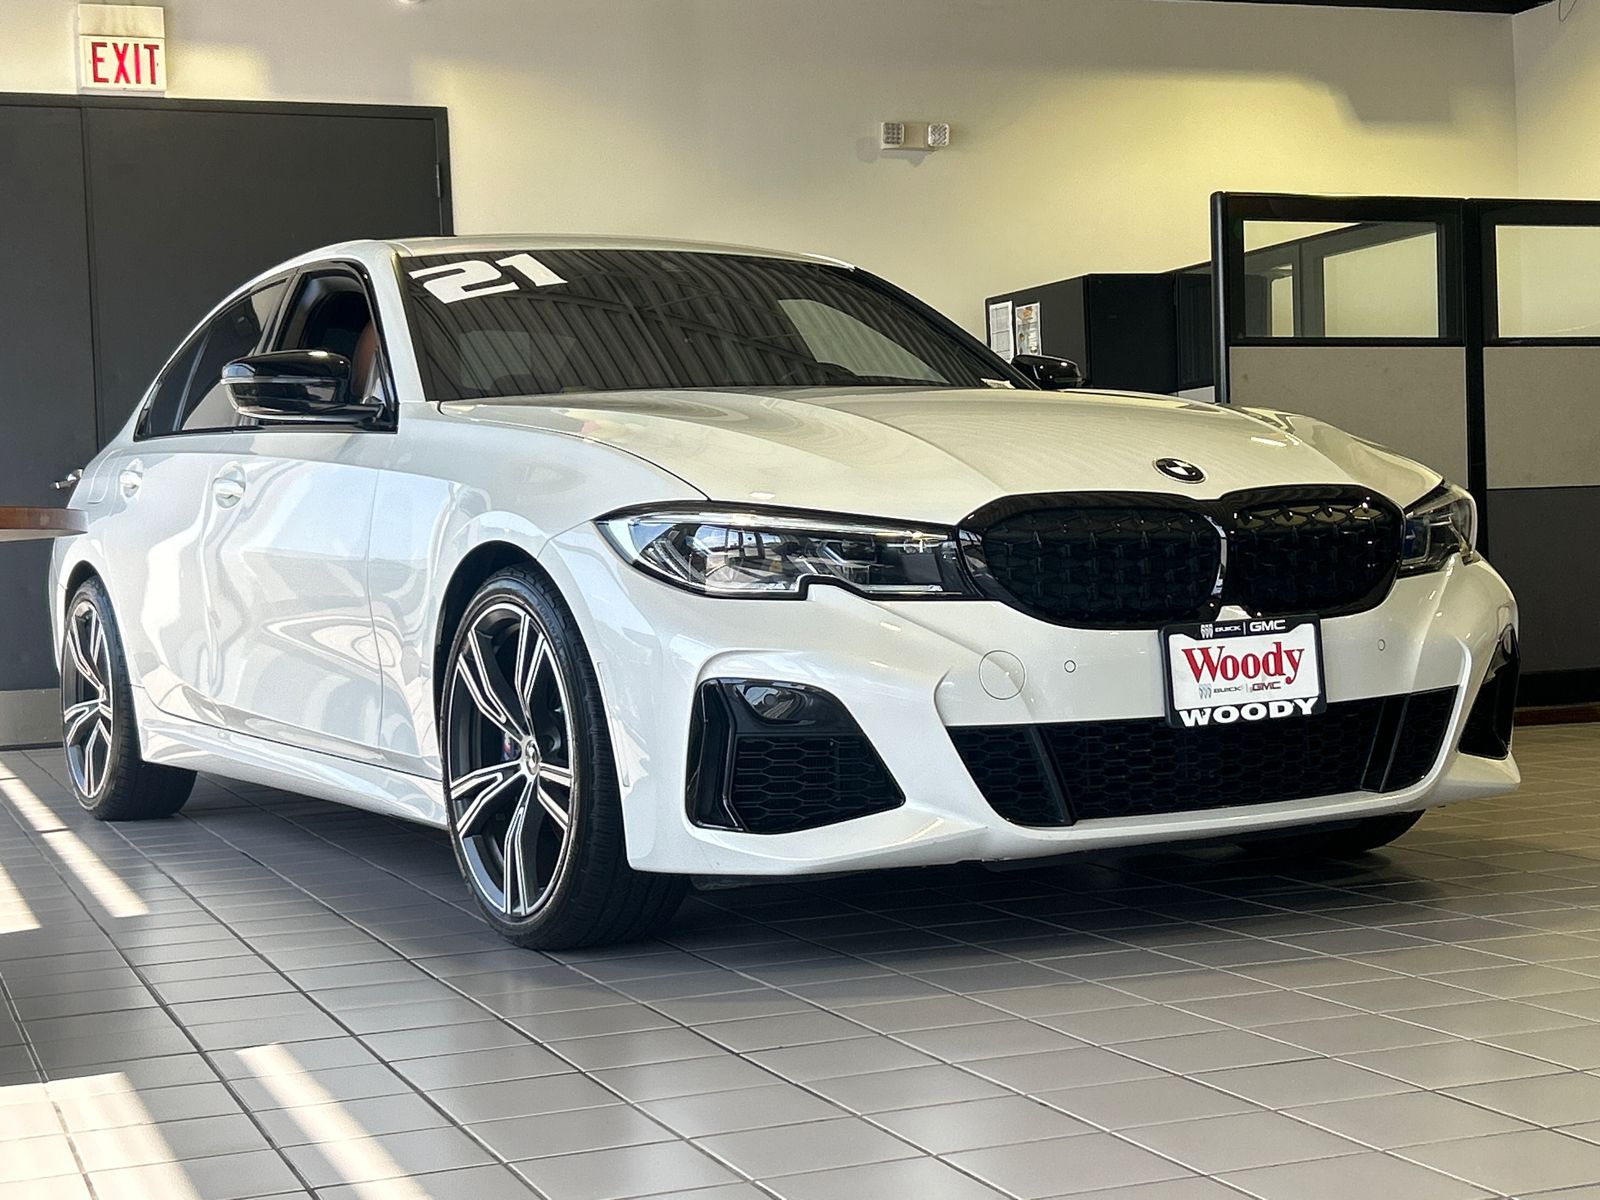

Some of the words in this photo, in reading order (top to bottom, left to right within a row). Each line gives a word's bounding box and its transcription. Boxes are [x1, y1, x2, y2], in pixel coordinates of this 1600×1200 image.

[91, 41, 160, 85] EXIT
[408, 253, 569, 304] 21
[1214, 625, 1242, 633] BUICK
[1249, 620, 1286, 632] GMC
[1181, 641, 1305, 684] Woody
[1213, 686, 1242, 694] BUICK
[1252, 681, 1282, 692] GMC
[1179, 697, 1319, 728] WOODY
